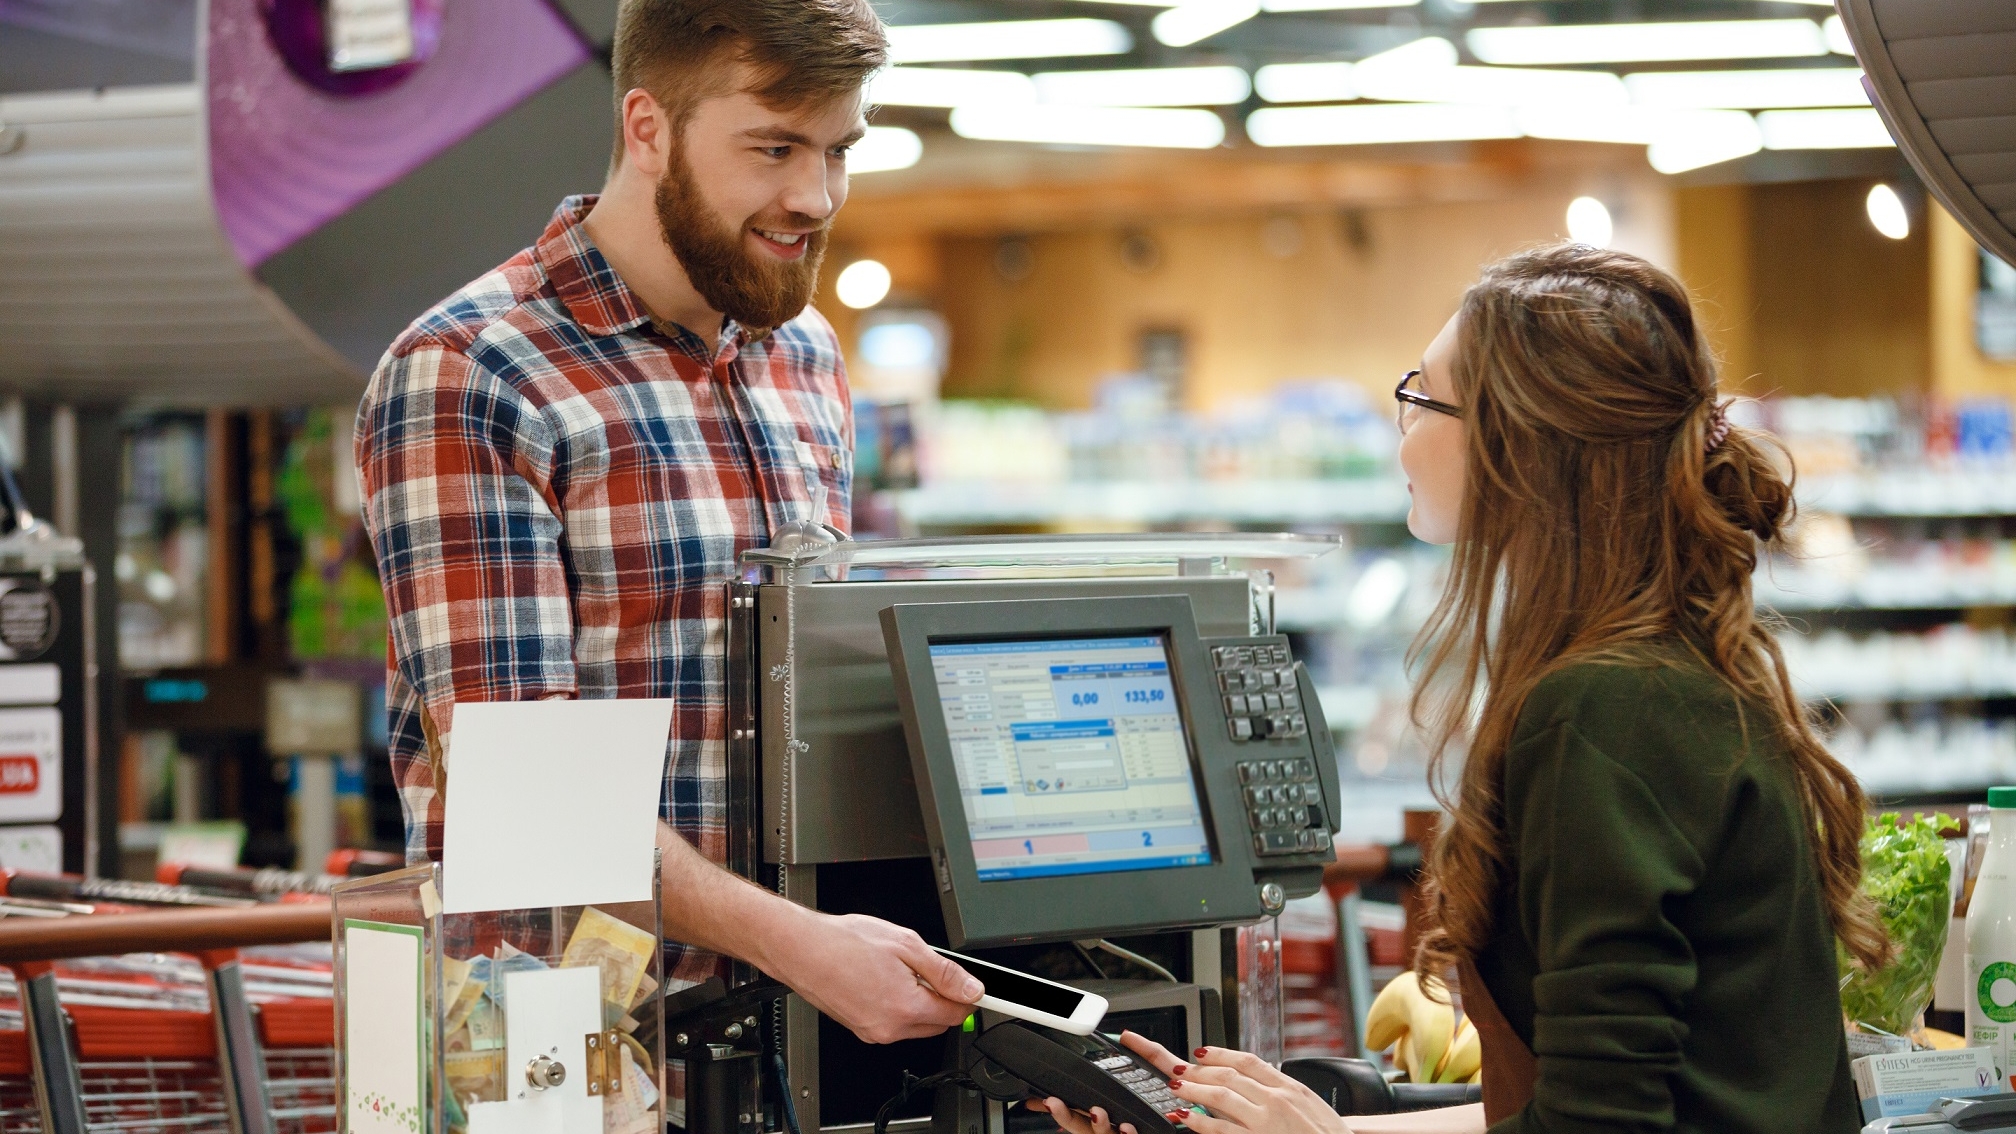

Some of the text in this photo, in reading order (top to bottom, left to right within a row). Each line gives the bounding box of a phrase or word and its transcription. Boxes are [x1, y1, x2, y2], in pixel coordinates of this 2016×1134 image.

[1072, 692, 1099, 707] 0,00
[1124, 689, 1165, 704] 133,50
[1141, 831, 1153, 847] 2
[1024, 839, 1034, 855] 1
[1876, 1058, 1910, 1071] EVITEST
